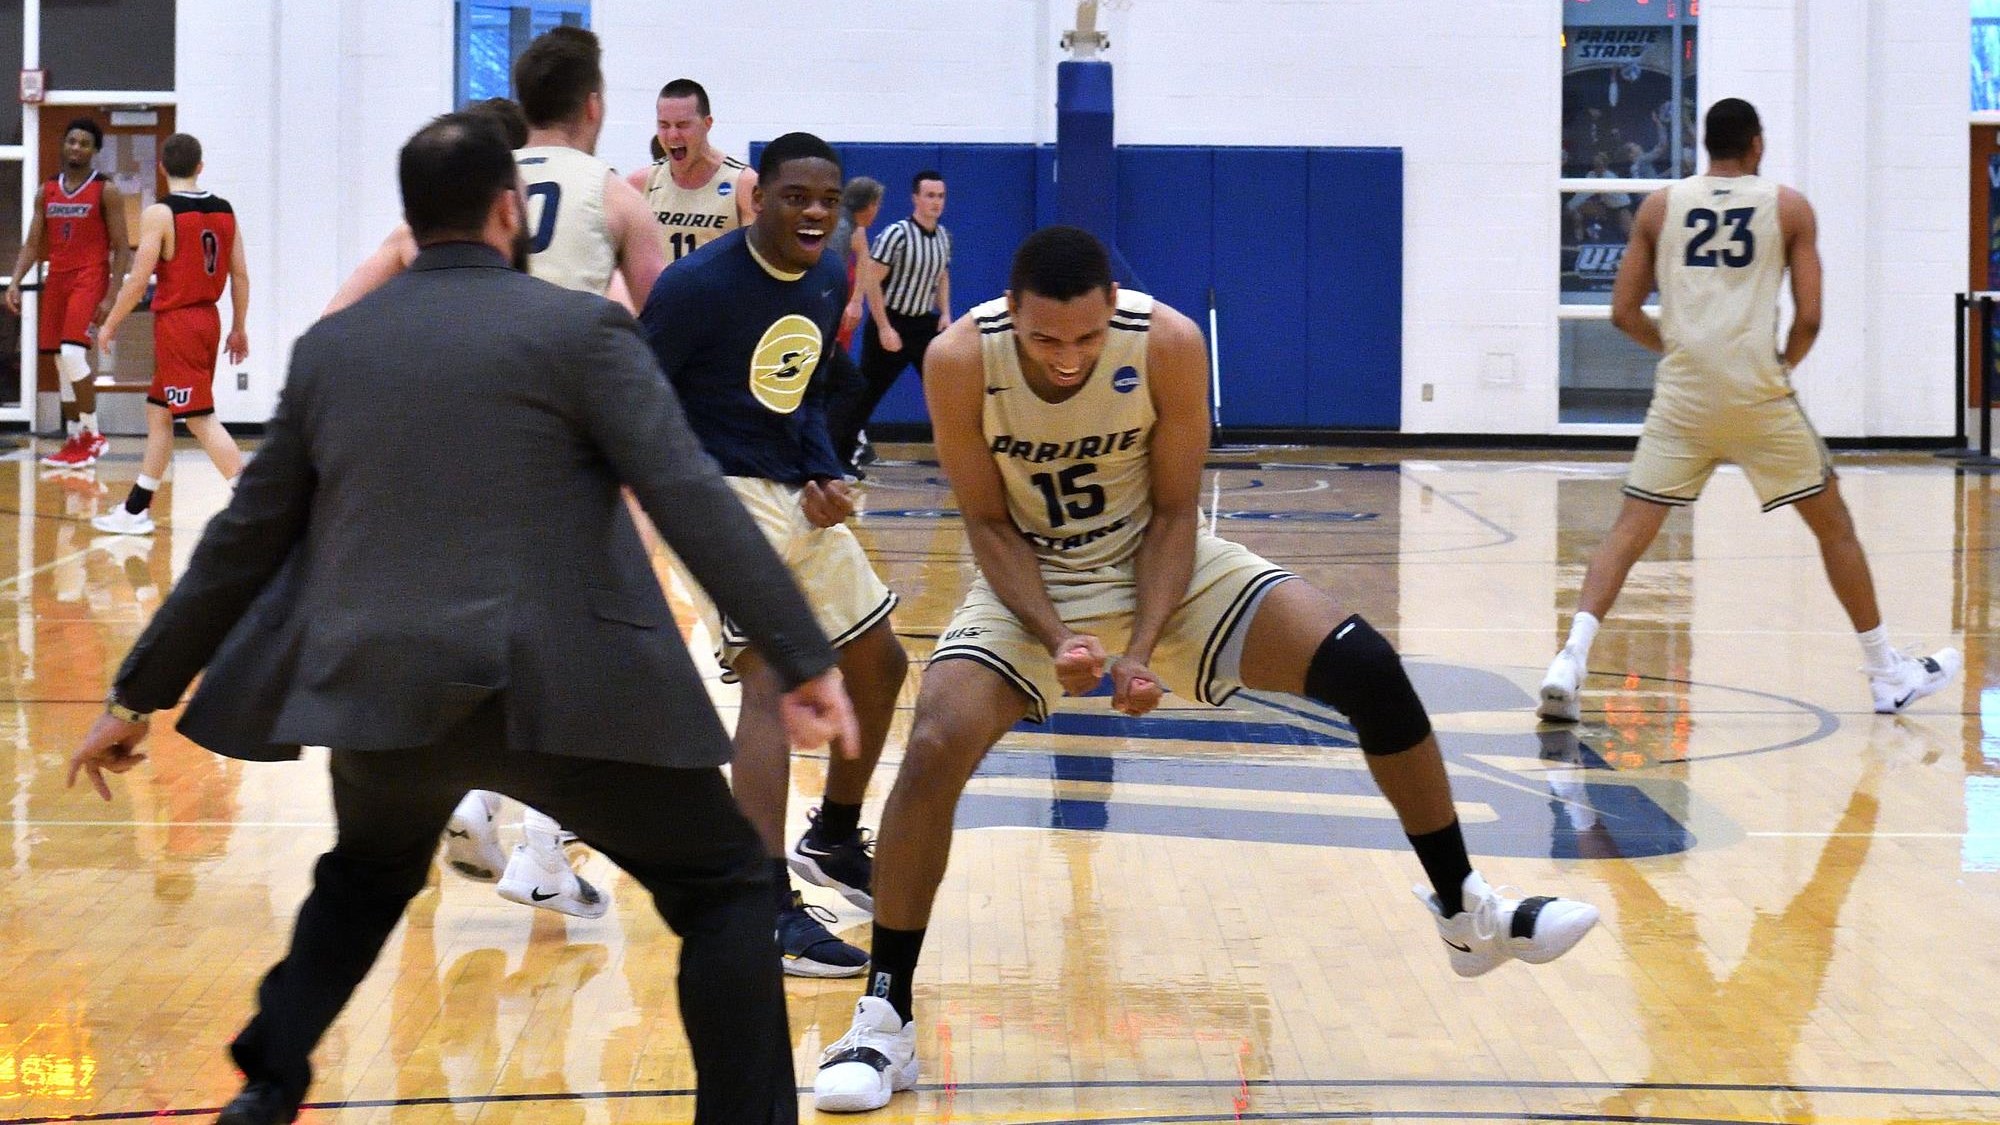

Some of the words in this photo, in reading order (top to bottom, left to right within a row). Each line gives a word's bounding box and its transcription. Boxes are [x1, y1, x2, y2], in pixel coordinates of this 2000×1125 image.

[1575, 29, 1660, 43] PRAIRIE
[1579, 45, 1644, 58] STARS
[654, 211, 728, 229] RAIRIE
[670, 232, 696, 260] 11
[1685, 207, 1756, 267] 23
[201, 230, 218, 275] 0
[165, 387, 191, 405] DU
[991, 428, 1142, 463] PRAIRIE
[1031, 463, 1105, 528] 15
